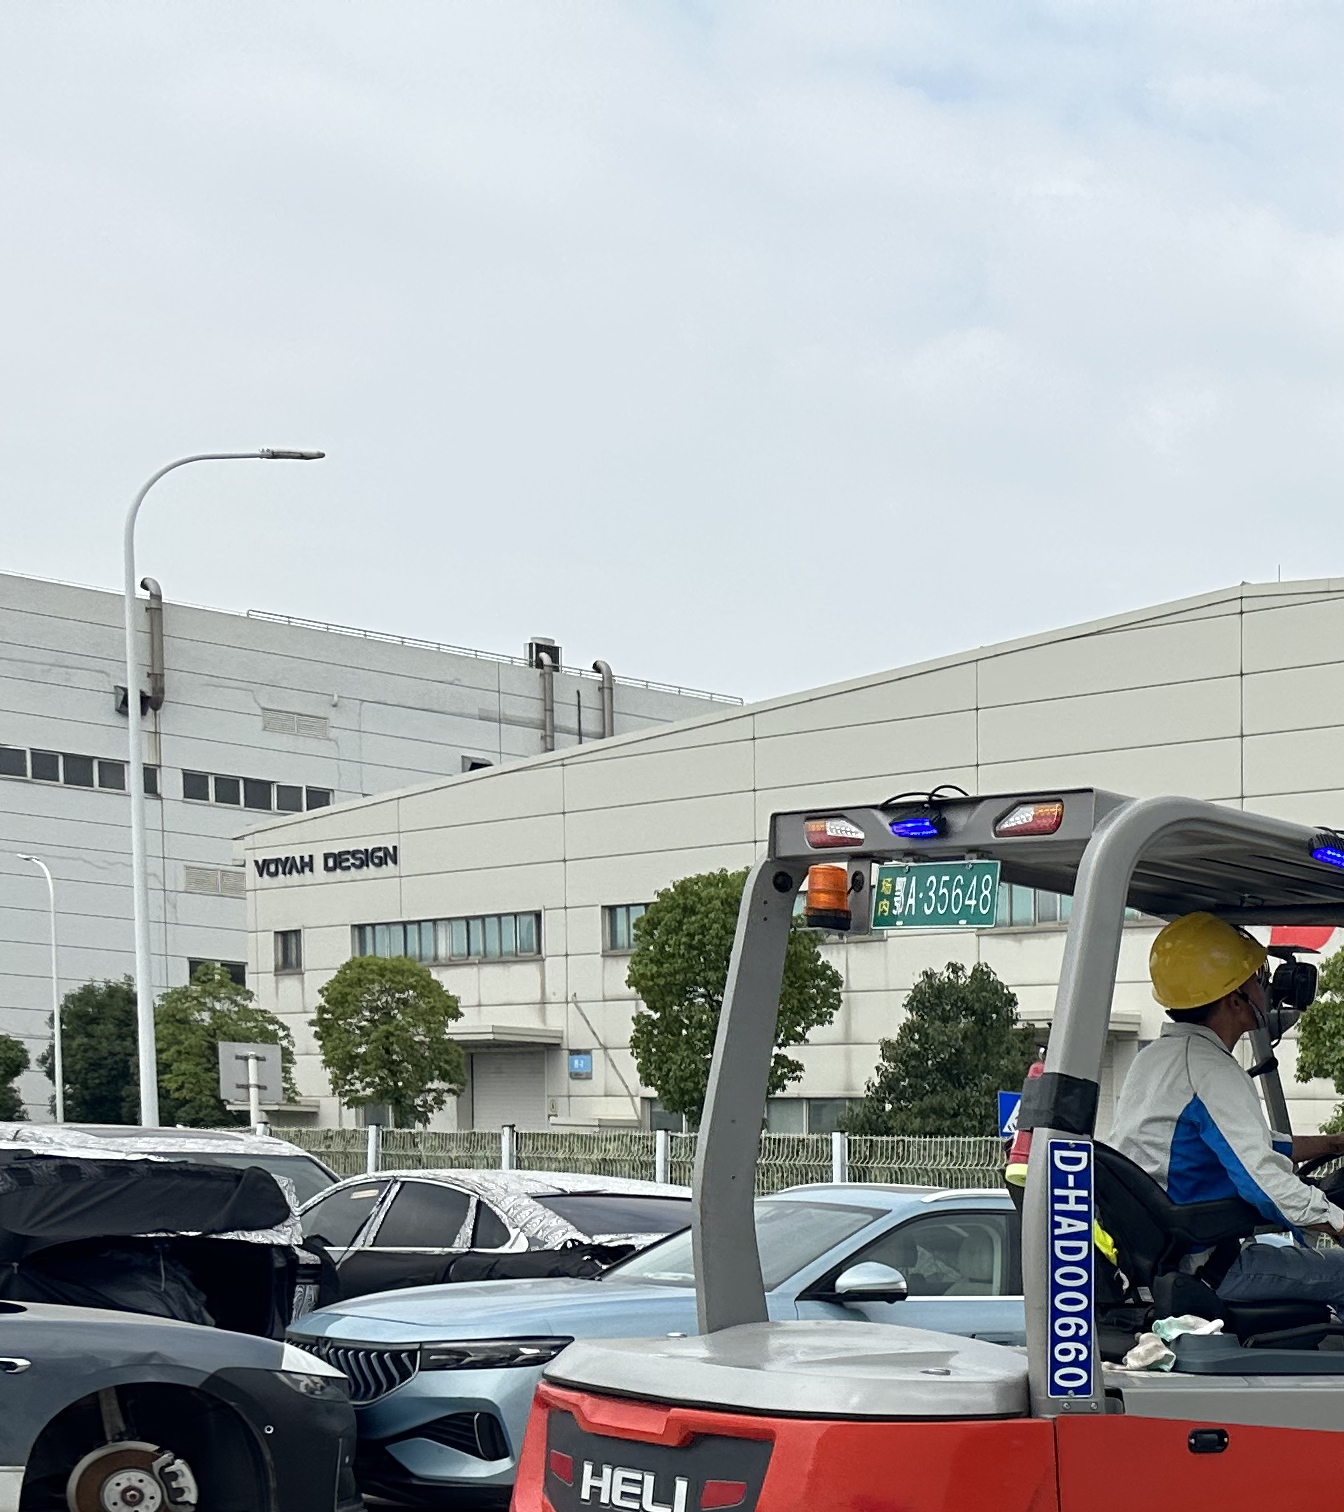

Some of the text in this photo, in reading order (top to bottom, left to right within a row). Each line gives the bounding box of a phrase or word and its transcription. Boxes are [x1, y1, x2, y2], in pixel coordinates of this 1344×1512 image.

[254, 845, 398, 878] VOYAH DESIGN
[1053, 1149, 1089, 1388] D-HAD00660
